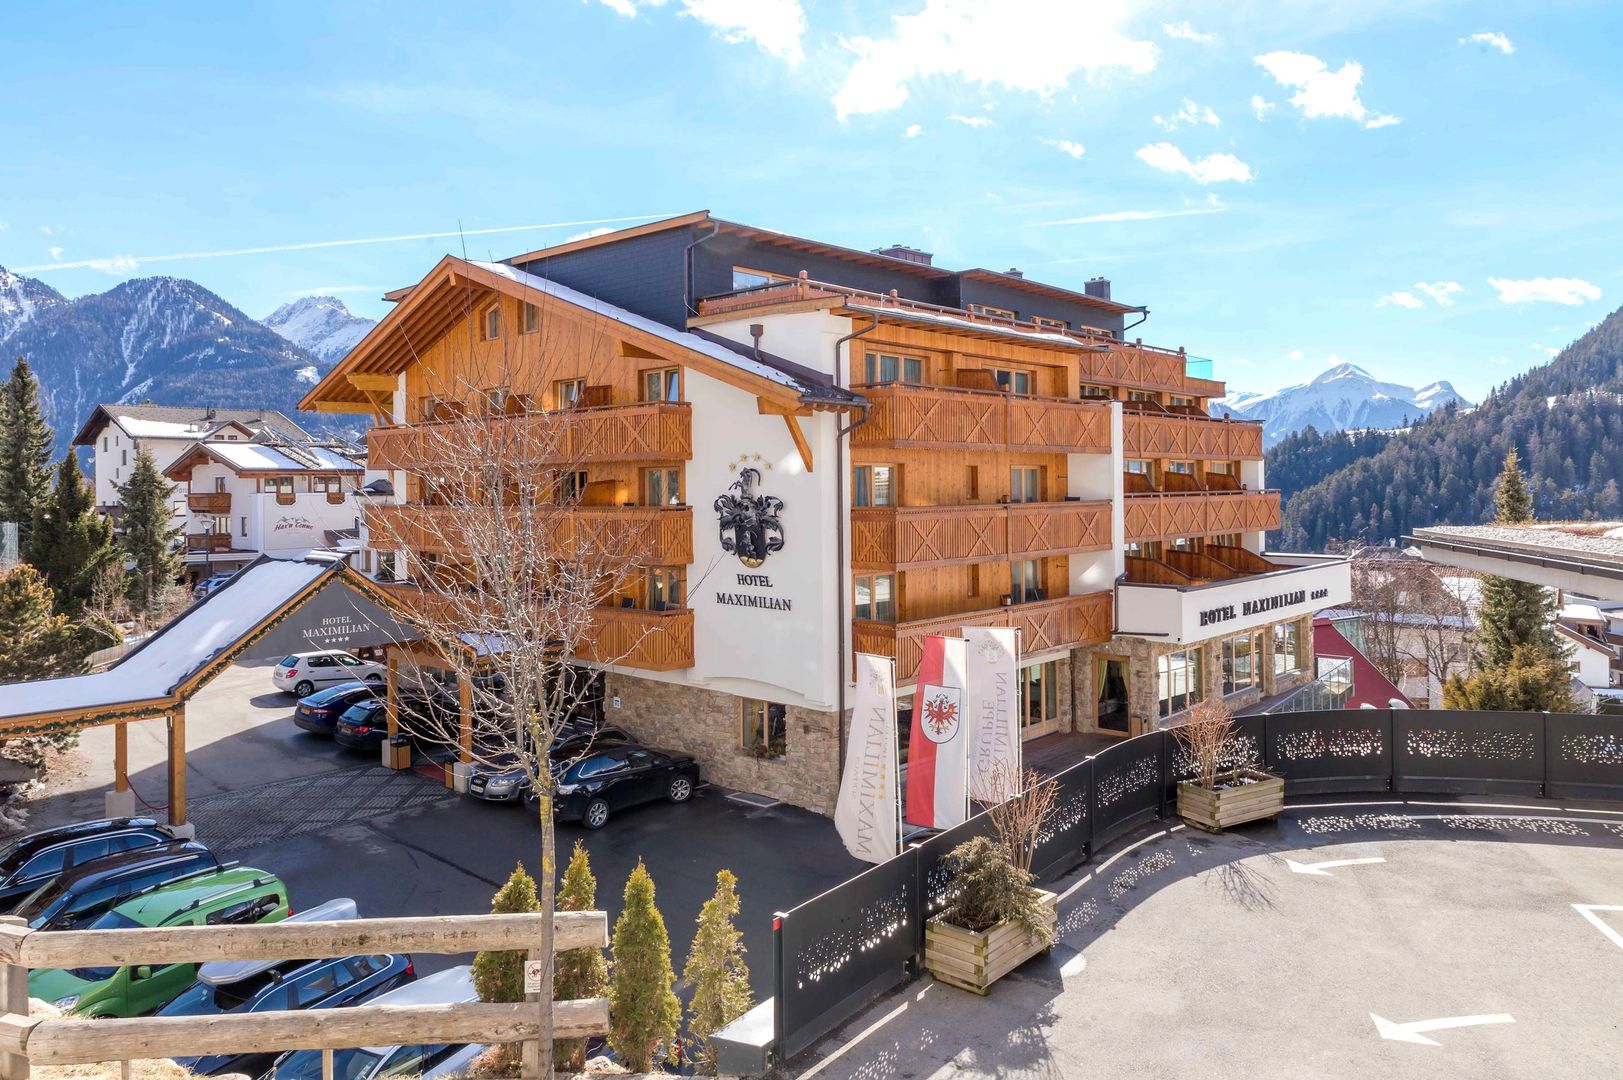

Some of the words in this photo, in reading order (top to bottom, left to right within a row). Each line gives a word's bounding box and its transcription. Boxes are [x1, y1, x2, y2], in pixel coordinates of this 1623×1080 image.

[736, 573, 774, 588] HOTEL
[716, 592, 792, 611] MAXIMILIAN
[1199, 604, 1236, 627] HOTEL
[1242, 589, 1306, 616] MAXIMILIAN
[322, 616, 352, 626] HOTEL
[303, 623, 371, 639] MAXIMILIAN
